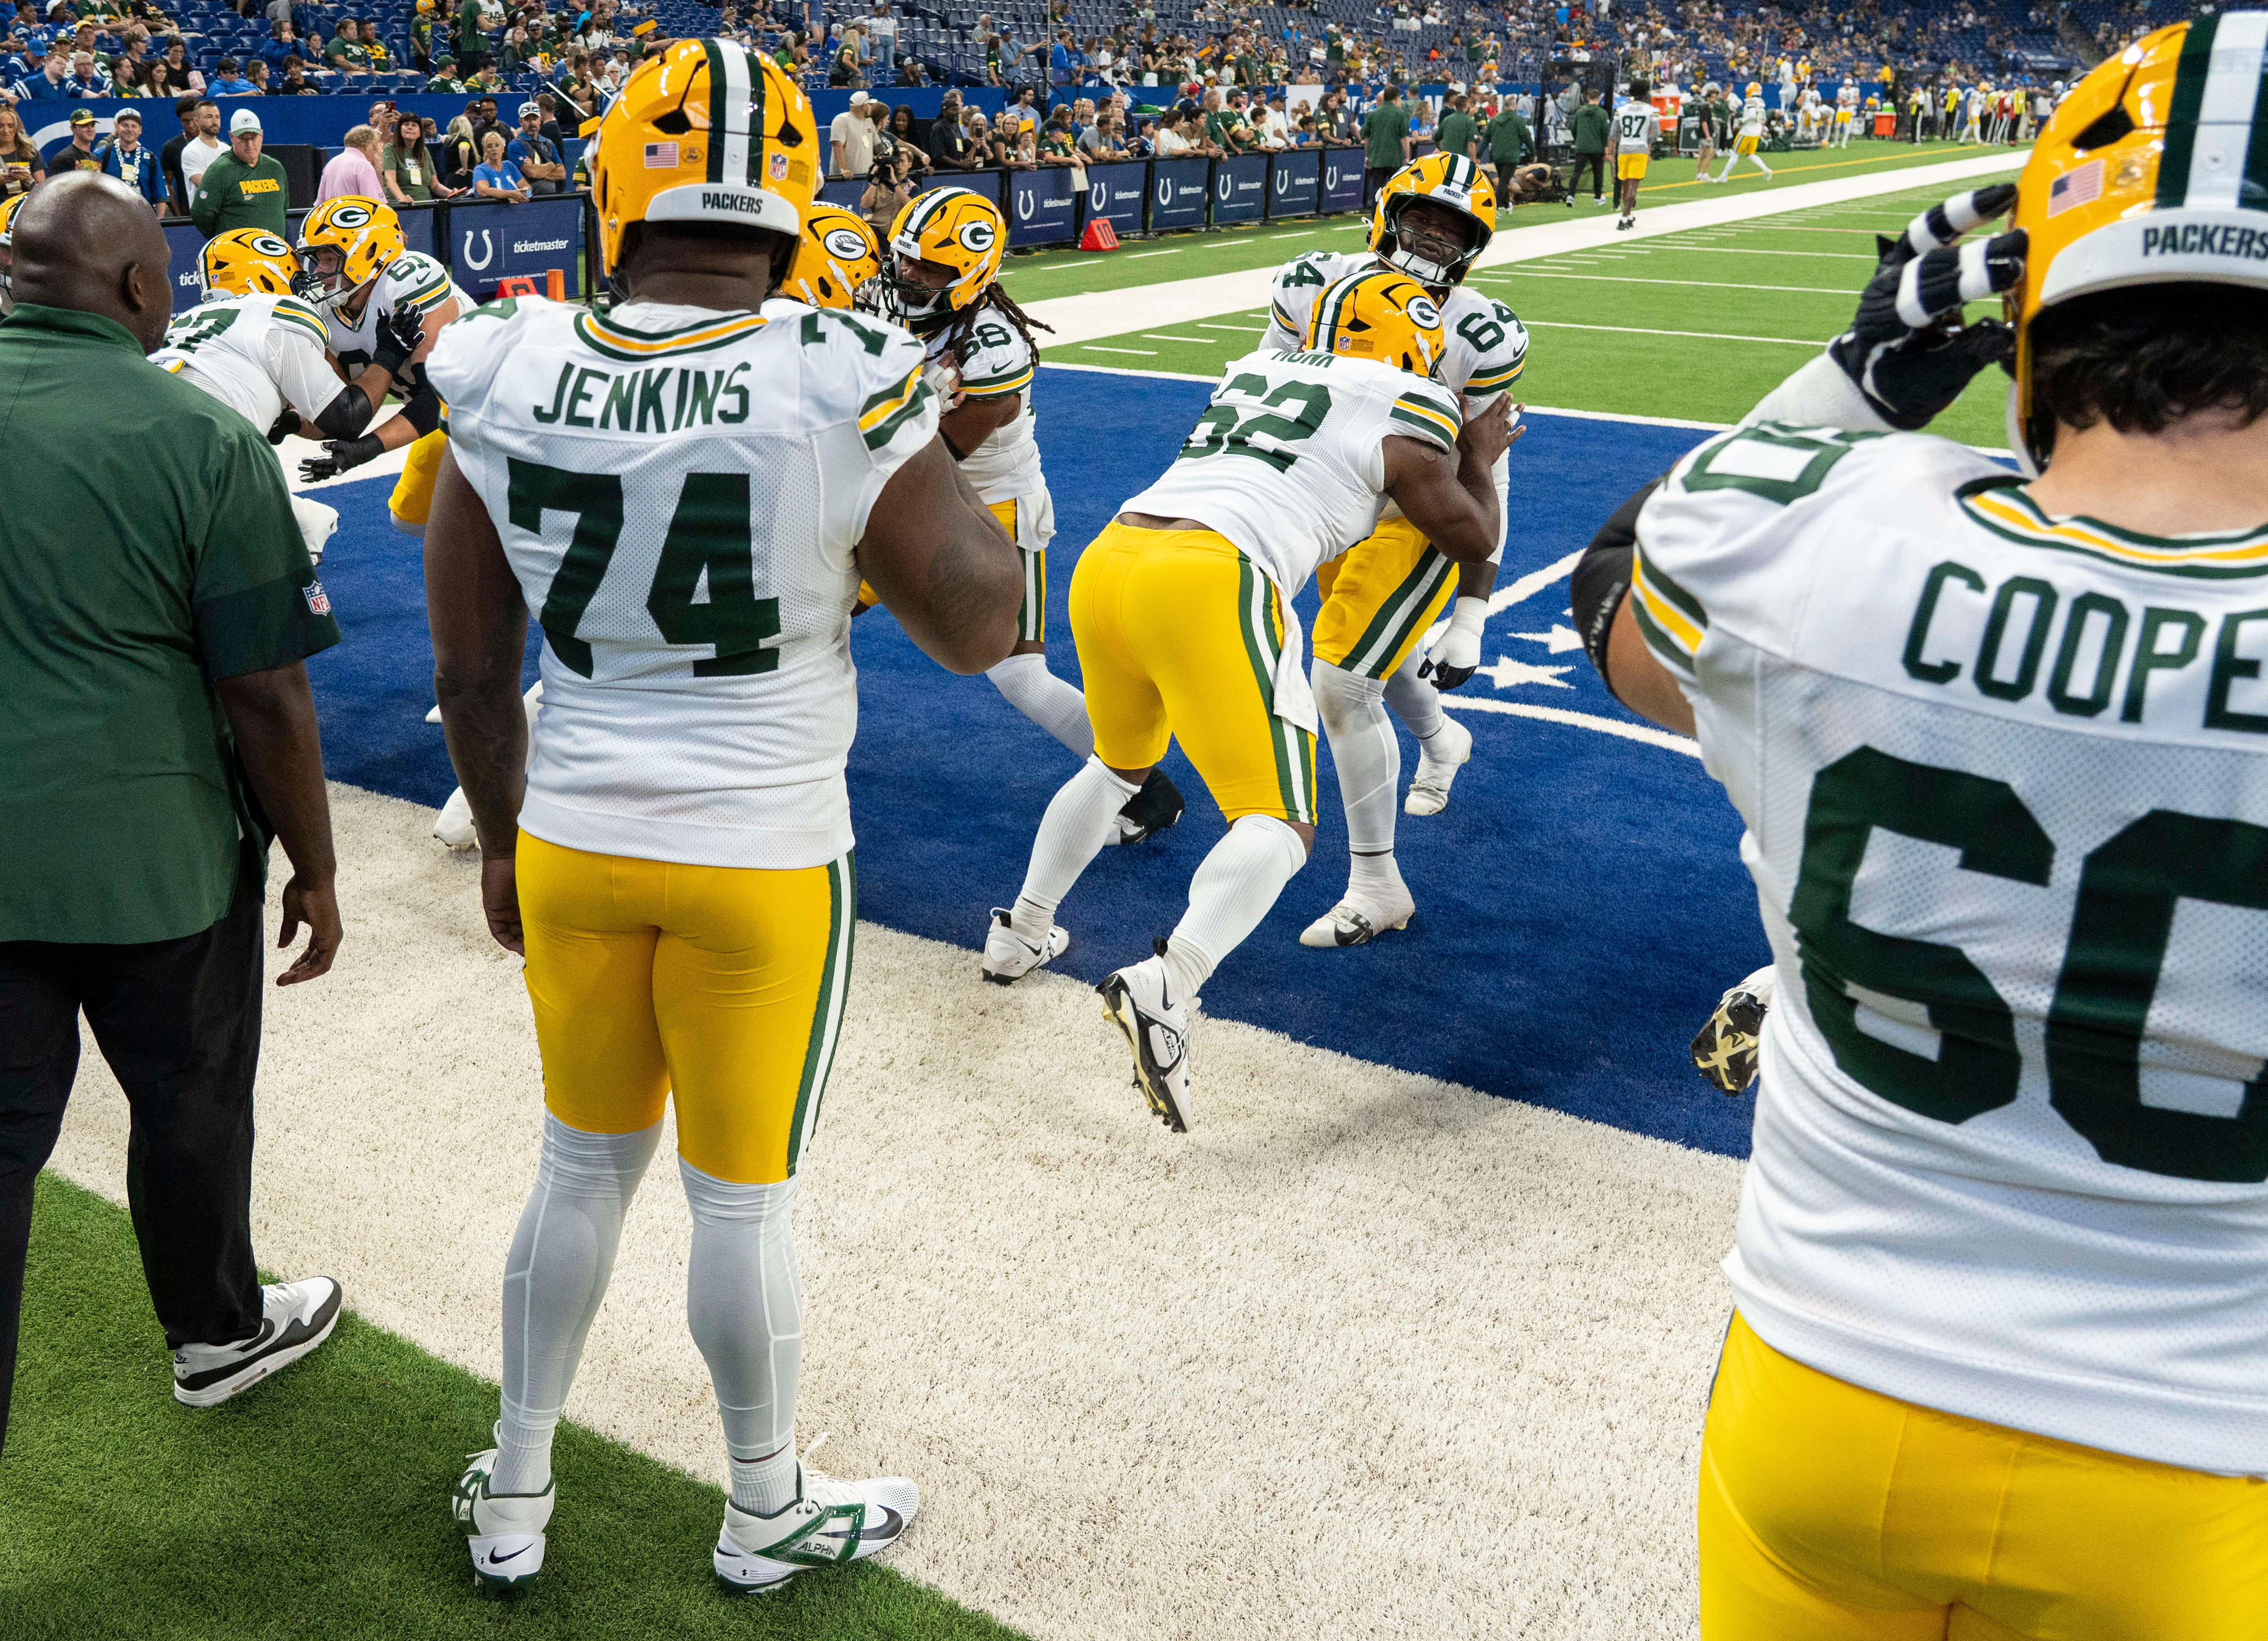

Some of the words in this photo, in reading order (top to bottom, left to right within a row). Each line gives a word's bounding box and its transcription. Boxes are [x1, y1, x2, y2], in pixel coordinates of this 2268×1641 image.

[1622, 115, 1646, 138] 87
[772, 163, 786, 179] NFL
[239, 178, 280, 195] PACKERS
[1443, 188, 1464, 201] PACKERS
[702, 192, 763, 215] PACKERS
[331, 206, 371, 229] G
[251, 236, 289, 257] G
[513, 238, 568, 253] ticketmaster
[823, 229, 867, 261] G
[960, 221, 995, 253] G
[1096, 224, 1117, 247] 10
[2142, 225, 2268, 260] PACKERS
[387, 256, 430, 282] 61
[1405, 295, 1441, 331] G
[1456, 298, 1525, 353] 64
[534, 361, 751, 433] JENKINS
[1177, 372, 1332, 474] 62
[507, 457, 781, 679] 74
[311, 596, 330, 611] NFL
[1902, 561, 2268, 733] COOPE
[1787, 744, 2268, 1184] 60
[1162, 1028, 1176, 1060] ALPHA
[797, 1541, 836, 1557] ALPHA
